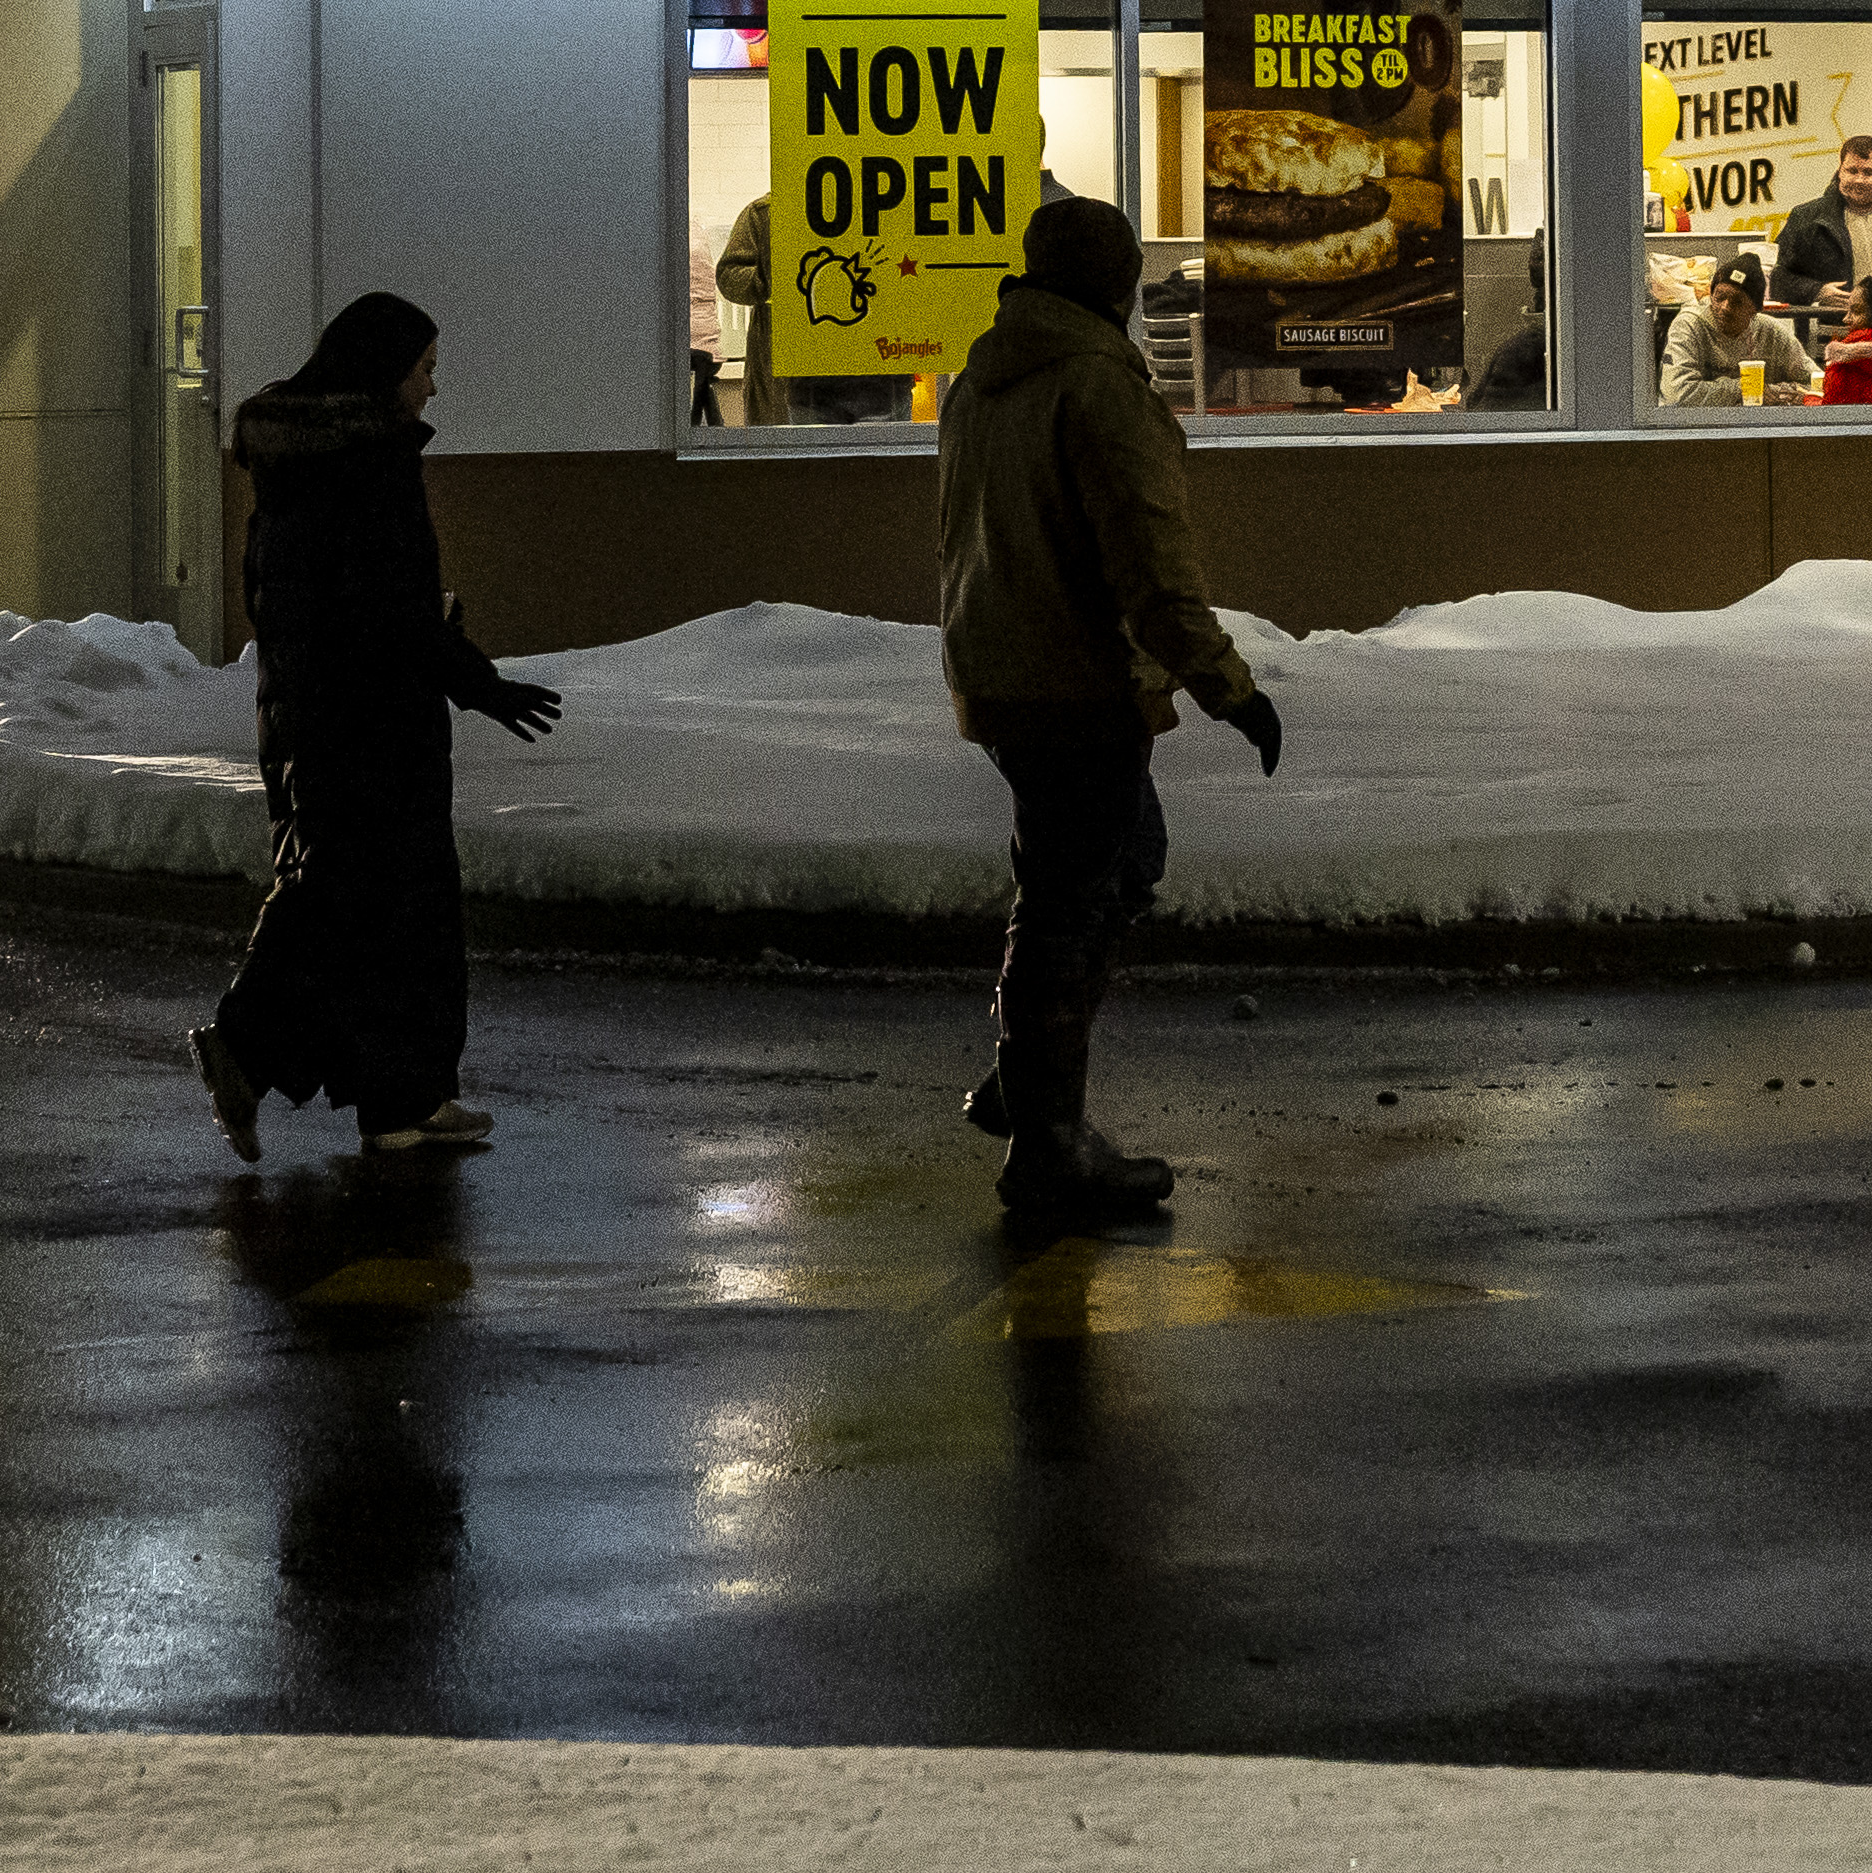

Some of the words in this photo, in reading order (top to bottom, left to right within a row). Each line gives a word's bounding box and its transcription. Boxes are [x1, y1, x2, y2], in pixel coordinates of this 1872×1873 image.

[1254, 13, 1412, 44] BREAKFAST
[1644, 37, 1692, 71] EXT
[1697, 28, 1773, 67] LEVEL
[1254, 47, 1364, 89] BLISS
[1380, 54, 1400, 68] TIL
[806, 46, 1005, 136] NOW
[1675, 80, 1799, 141] THERN
[805, 155, 1006, 239] OPEN
[874, 336, 943, 361] Bojangles
[1283, 328, 1336, 342] SAUSAGE
[1339, 328, 1385, 341] BISCUIT
